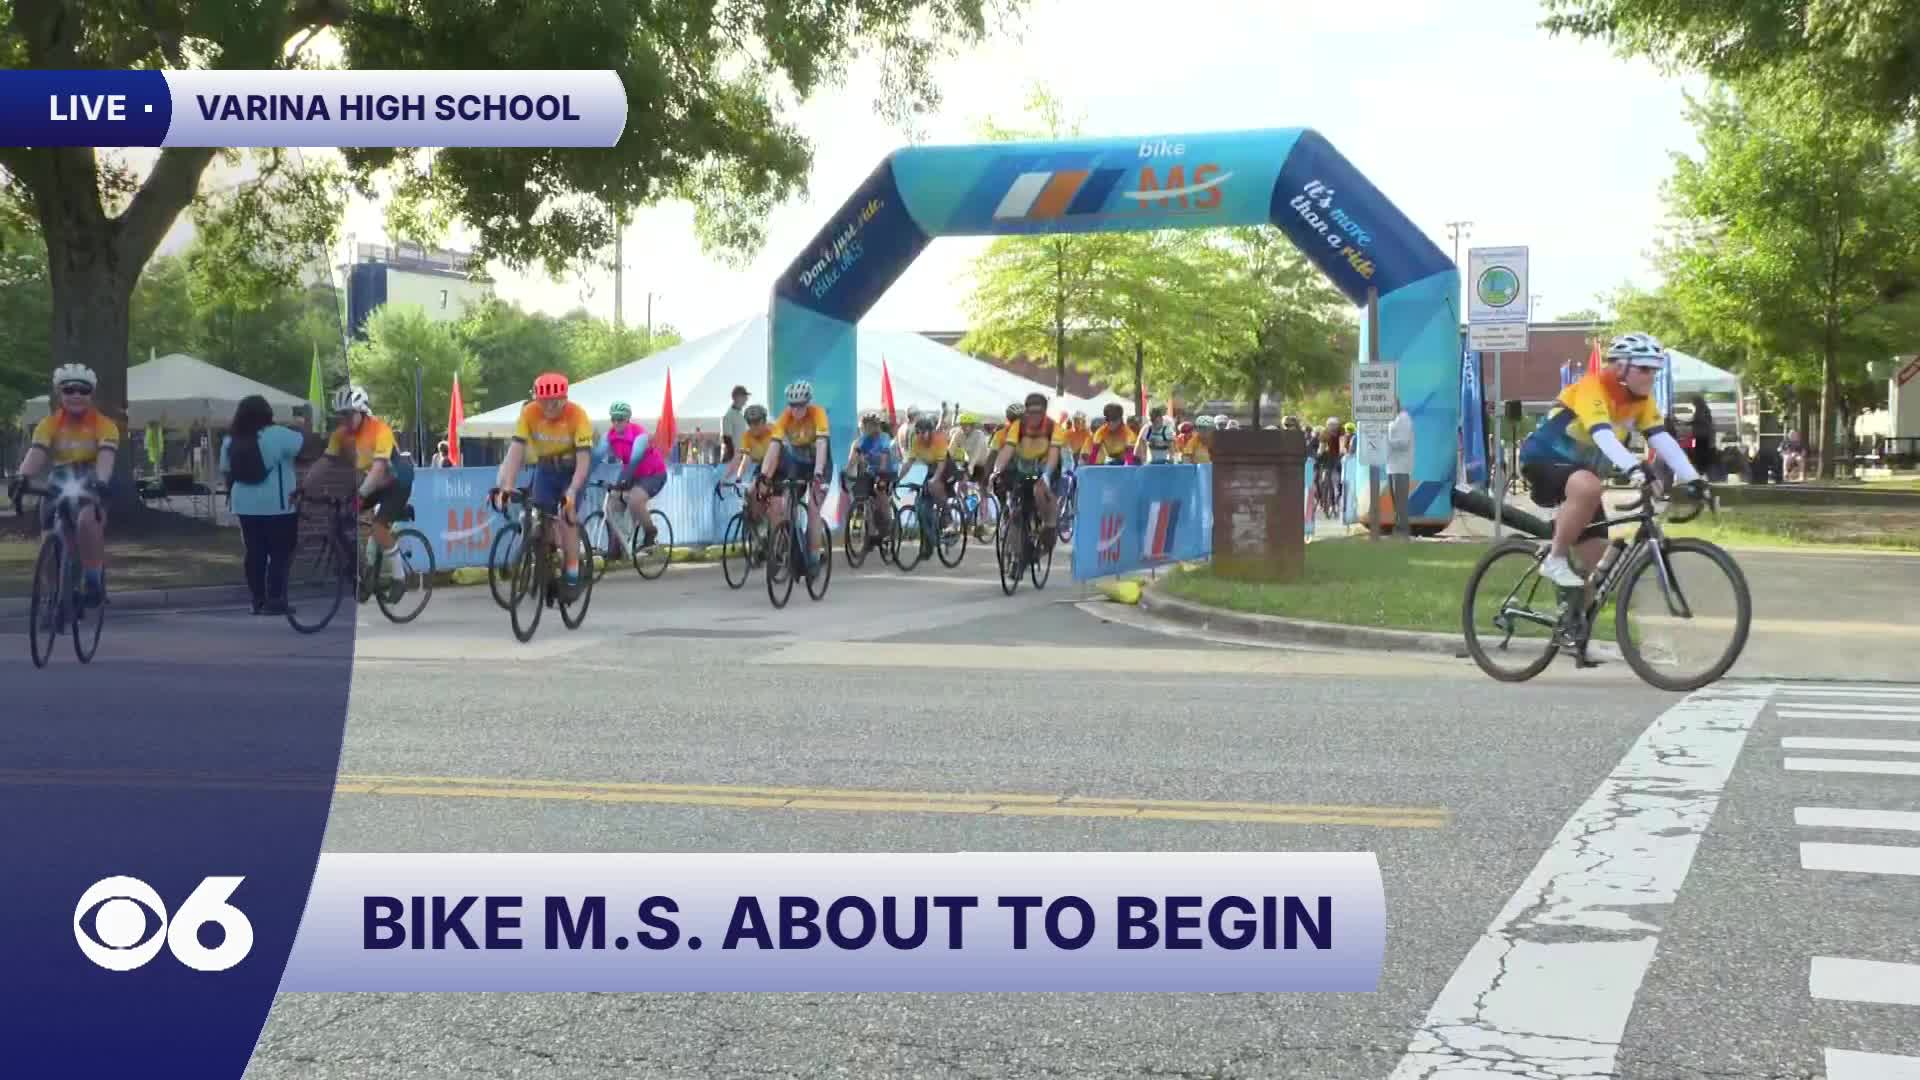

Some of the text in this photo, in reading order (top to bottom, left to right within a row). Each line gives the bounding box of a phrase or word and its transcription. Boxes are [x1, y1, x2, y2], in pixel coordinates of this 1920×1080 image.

[1138, 139, 1185, 158] bike
[1139, 164, 1223, 209] MS
[1290, 195, 1329, 236] than
[1327, 234, 1342, 248] a
[1331, 209, 1371, 247] more
